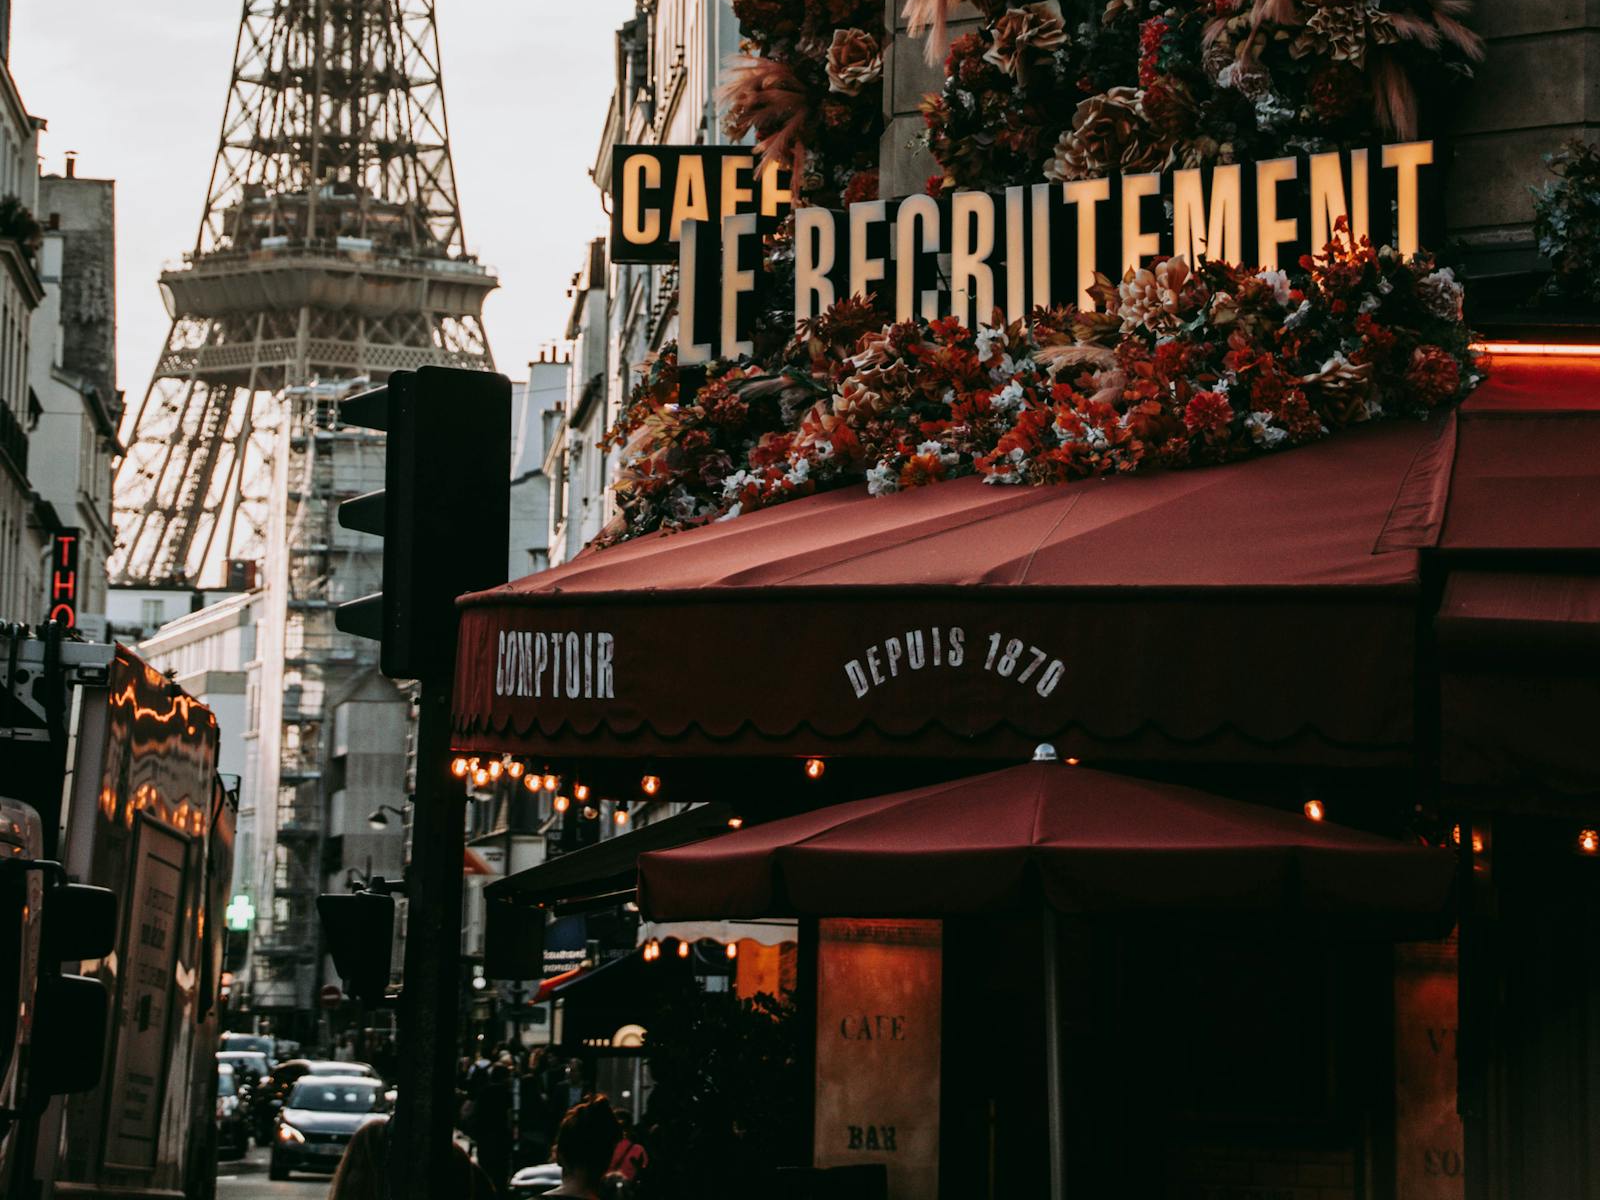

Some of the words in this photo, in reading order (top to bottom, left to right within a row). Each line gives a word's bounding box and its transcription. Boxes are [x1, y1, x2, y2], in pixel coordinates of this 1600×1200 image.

[677, 213, 757, 366] LE
[795, 140, 1434, 341] RECRUTEMENT
[496, 630, 615, 699] COMPTOIR
[844, 627, 965, 699] DEPUIS
[984, 632, 1066, 698] 1870
[848, 1125, 899, 1153] BAR
